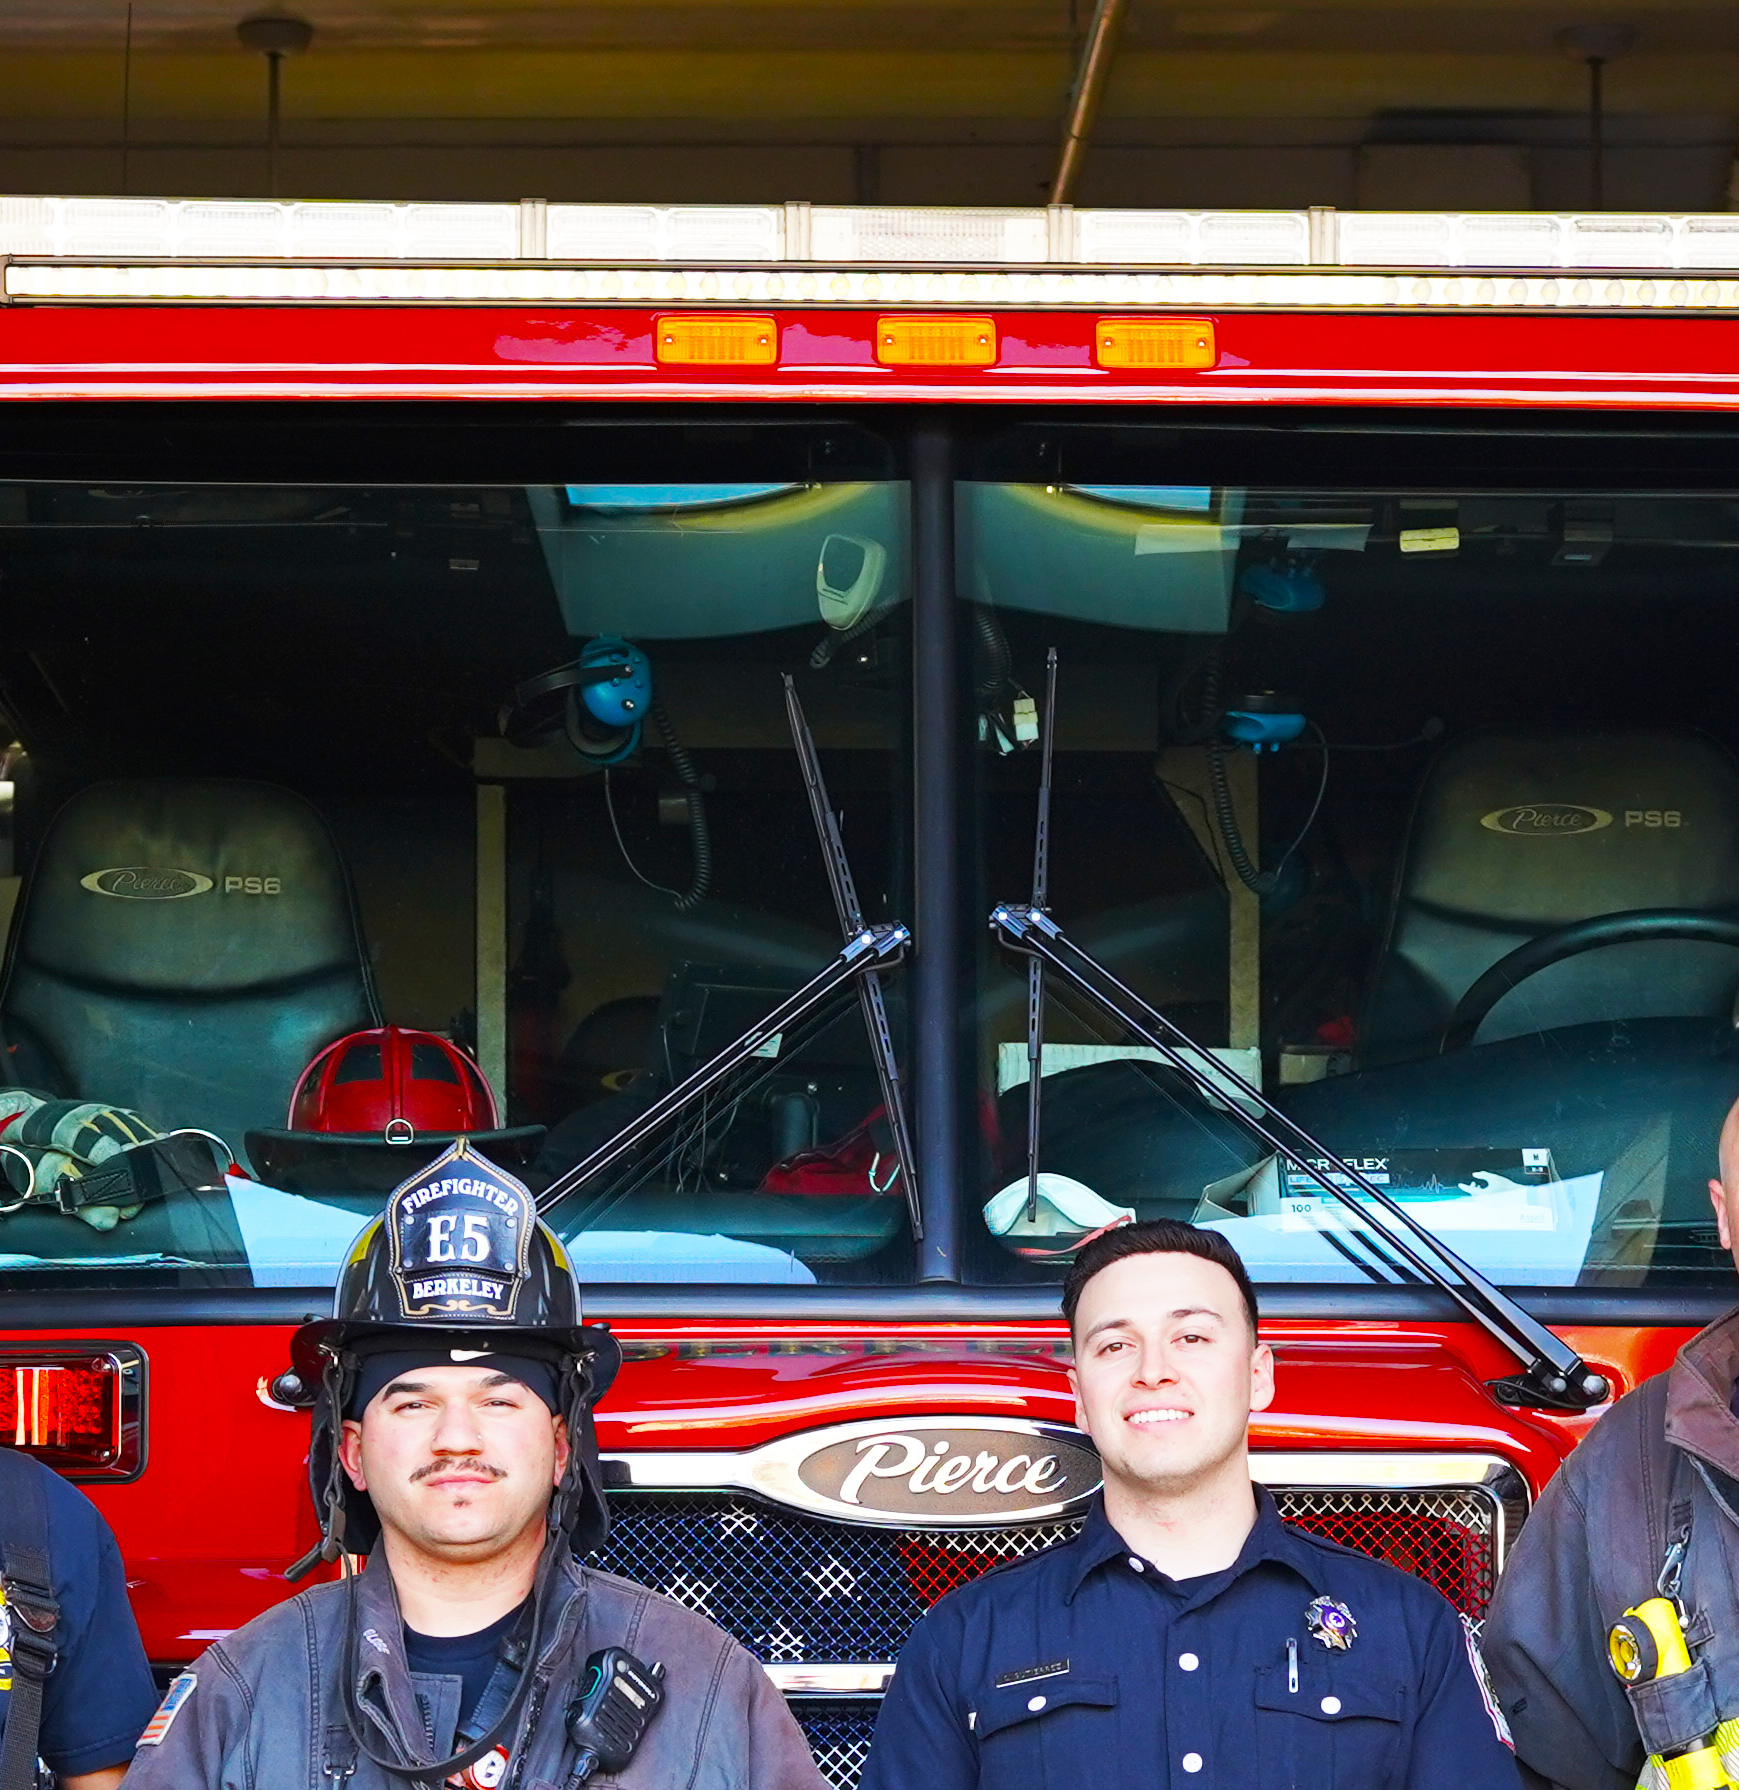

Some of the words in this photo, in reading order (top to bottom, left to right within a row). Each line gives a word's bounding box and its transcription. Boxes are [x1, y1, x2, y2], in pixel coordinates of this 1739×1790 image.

[1512, 808, 1582, 830] Pierce
[1624, 810, 1681, 827] PS6
[111, 870, 183, 891] Pierce
[225, 876, 281, 895] PS6
[401, 1178, 519, 1217] FIREFIGHTER
[1291, 1204, 1312, 1213] 100
[426, 1214, 491, 1263] E5
[412, 1278, 504, 1300] BERKELEY
[839, 1434, 1068, 1504] Pierce
